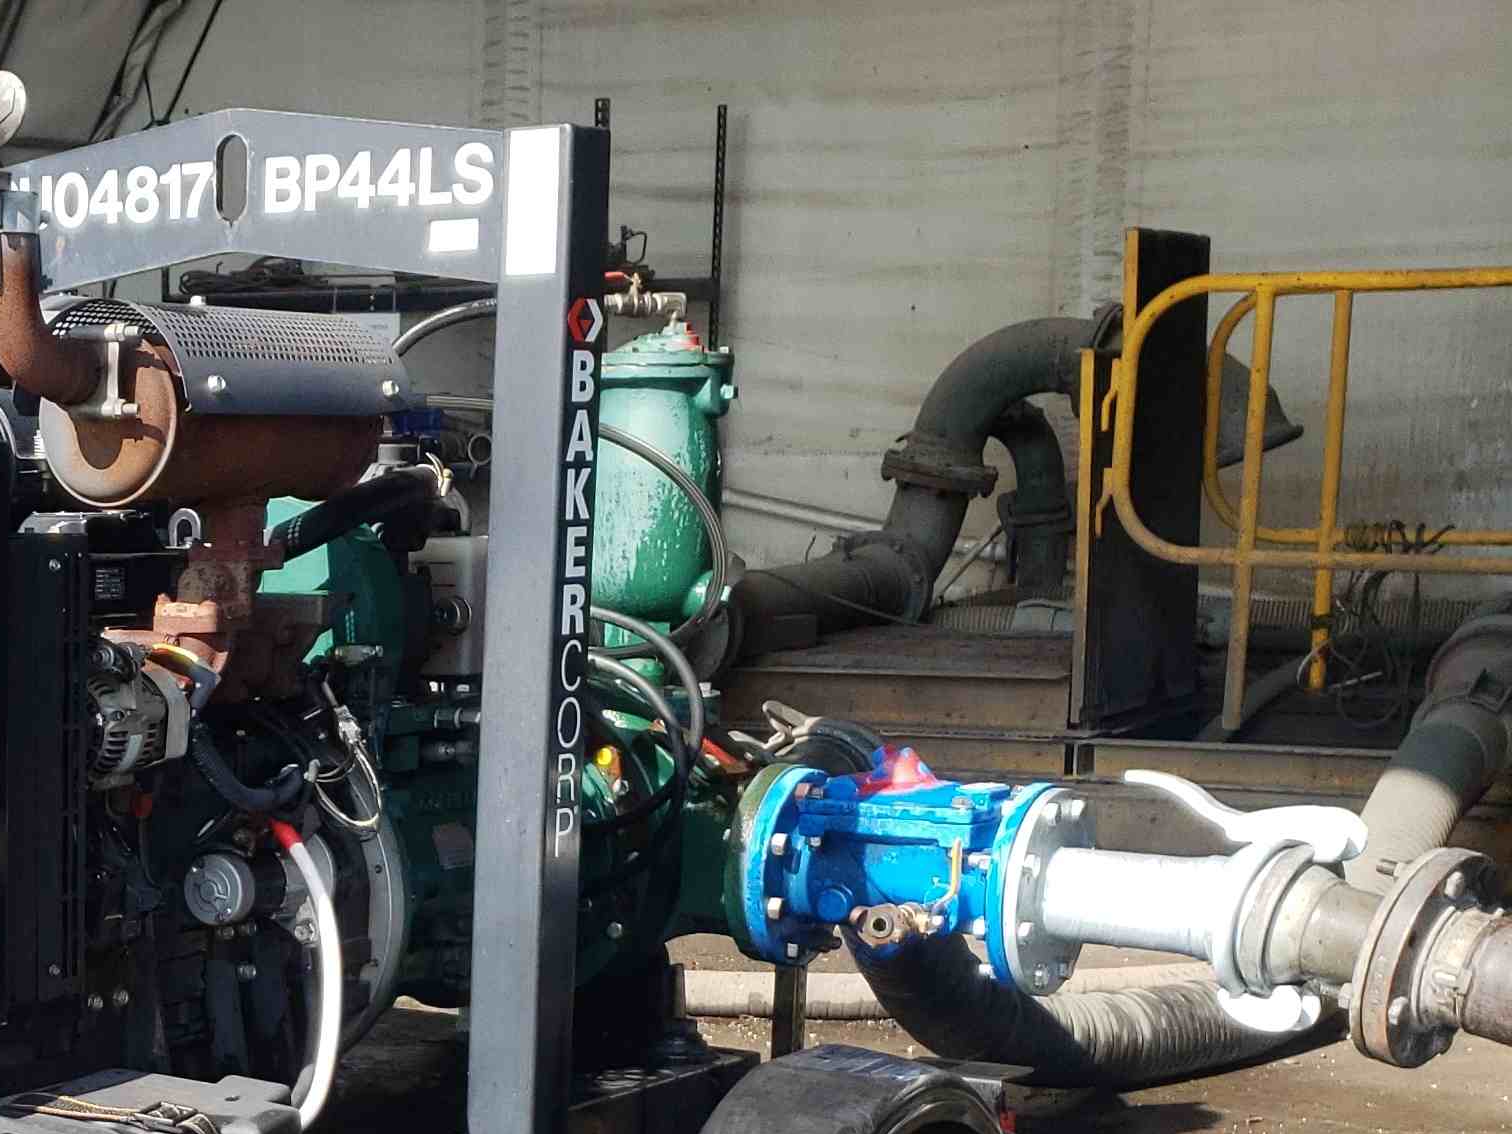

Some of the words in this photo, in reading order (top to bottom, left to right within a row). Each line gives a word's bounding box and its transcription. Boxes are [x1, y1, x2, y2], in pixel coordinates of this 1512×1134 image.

[10, 161, 214, 230] 04817
[264, 142, 494, 213] BP44LS
[554, 349, 595, 858] BAKERCORP
